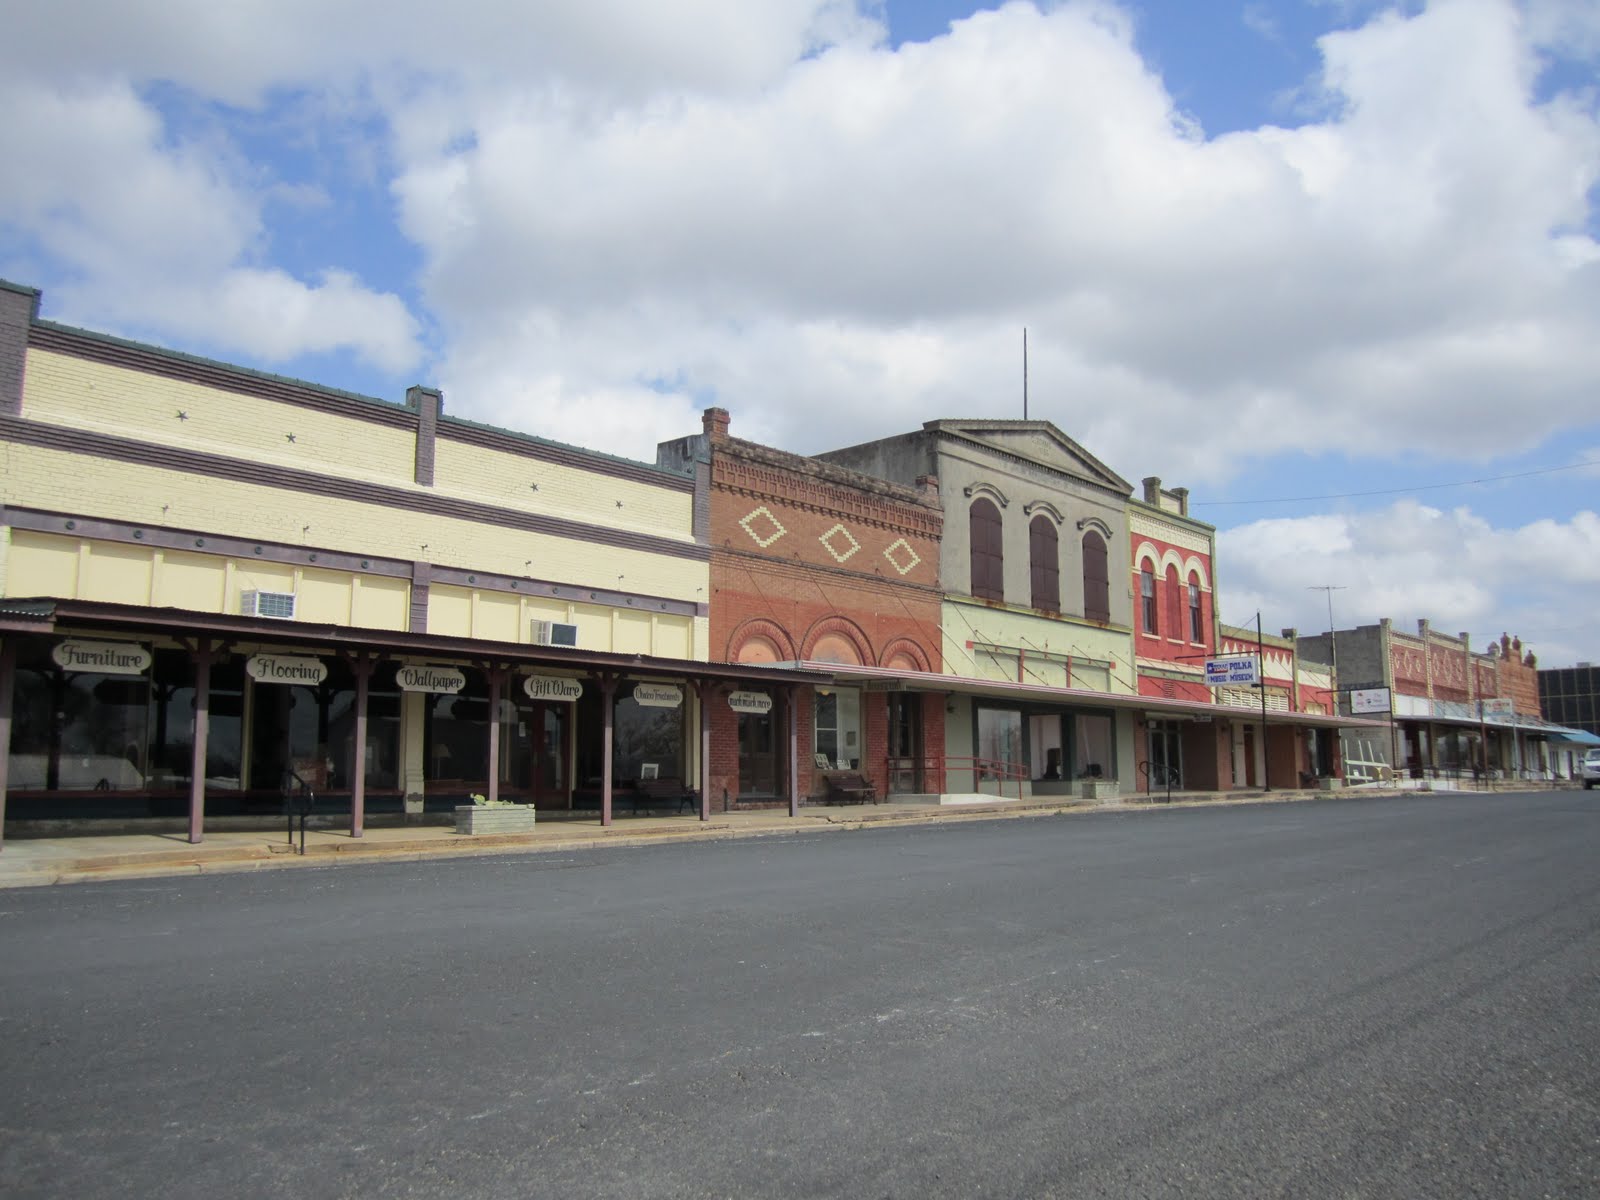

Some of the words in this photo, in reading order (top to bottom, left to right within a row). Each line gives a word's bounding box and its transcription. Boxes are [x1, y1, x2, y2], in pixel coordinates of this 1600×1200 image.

[61, 644, 143, 668] Furniture
[1229, 661, 1253, 670] POLKA
[256, 657, 321, 682] Flooring
[401, 669, 463, 689] Wallpaper
[1210, 674, 1227, 683] MUSIC
[1229, 673, 1254, 682] MUSEUM
[530, 679, 550, 697] Gift
[550, 679, 580, 696] Ware
